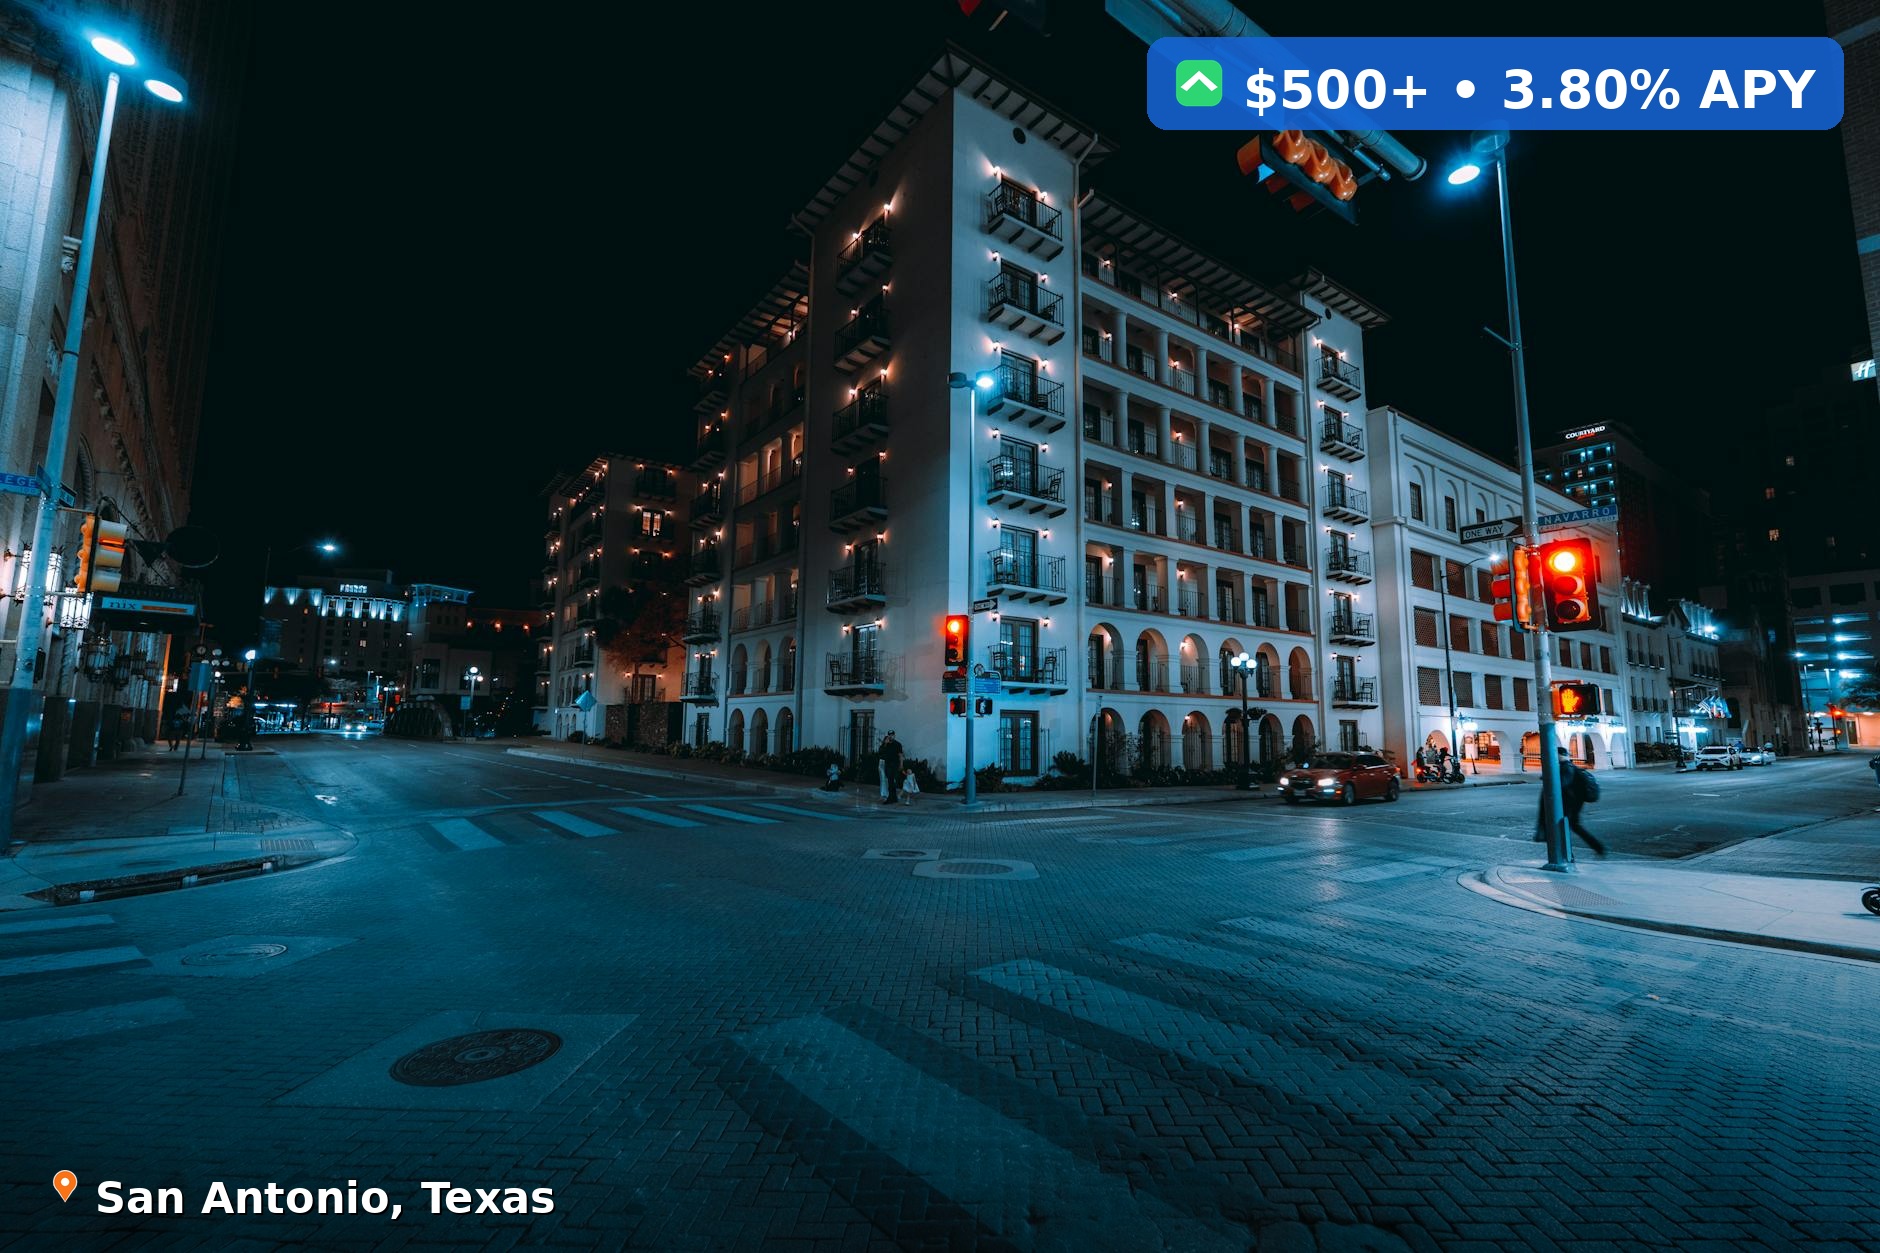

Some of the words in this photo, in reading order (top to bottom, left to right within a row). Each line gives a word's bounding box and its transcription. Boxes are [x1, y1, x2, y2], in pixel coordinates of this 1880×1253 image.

[1565, 426, 1606, 439] COURTYARD
[0, 474, 37, 487] EGE
[1544, 508, 1610, 525] NAVARRO
[1465, 528, 1482, 539] ONE
[1485, 524, 1503, 535] WAY
